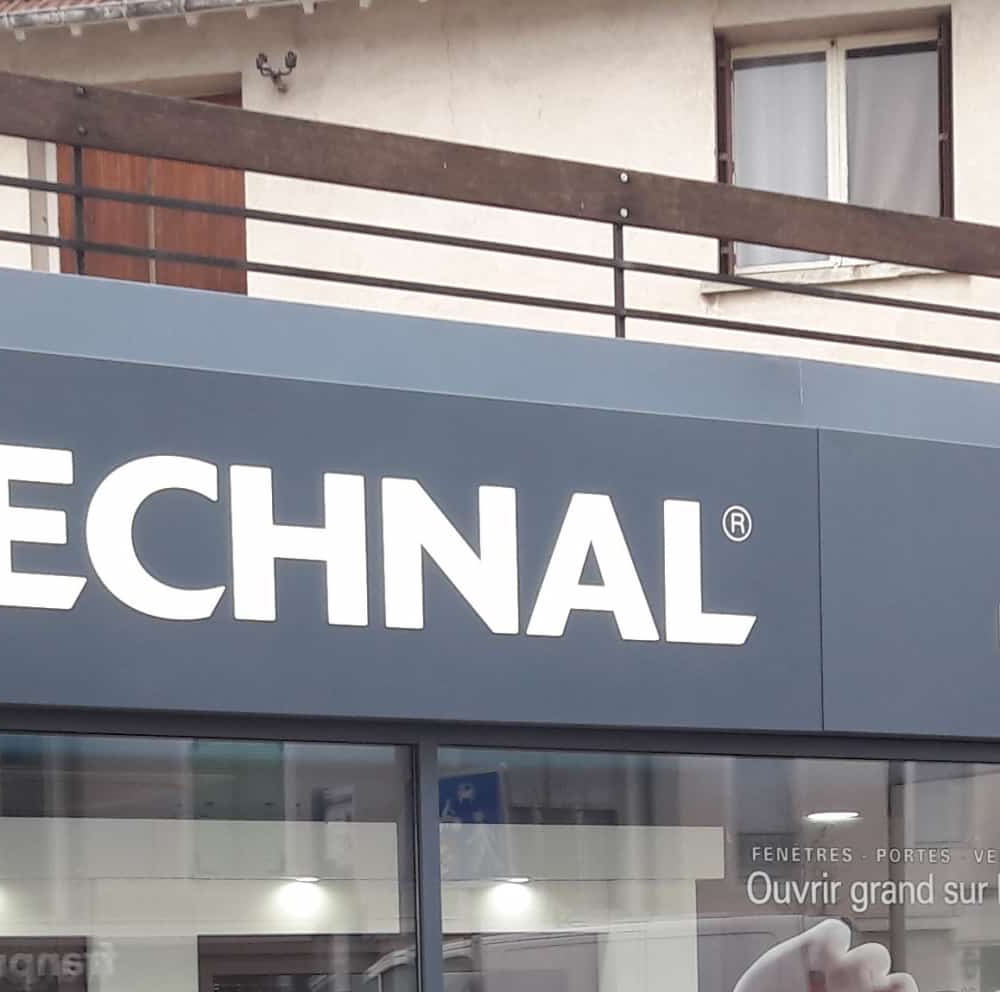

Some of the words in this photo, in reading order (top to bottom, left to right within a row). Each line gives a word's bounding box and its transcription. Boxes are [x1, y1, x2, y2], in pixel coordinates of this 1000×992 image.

[876, 848, 951, 864] PORTES
[747, 871, 842, 905] Ouvrir
[850, 873, 934, 913] grand
[943, 881, 989, 905] sur
